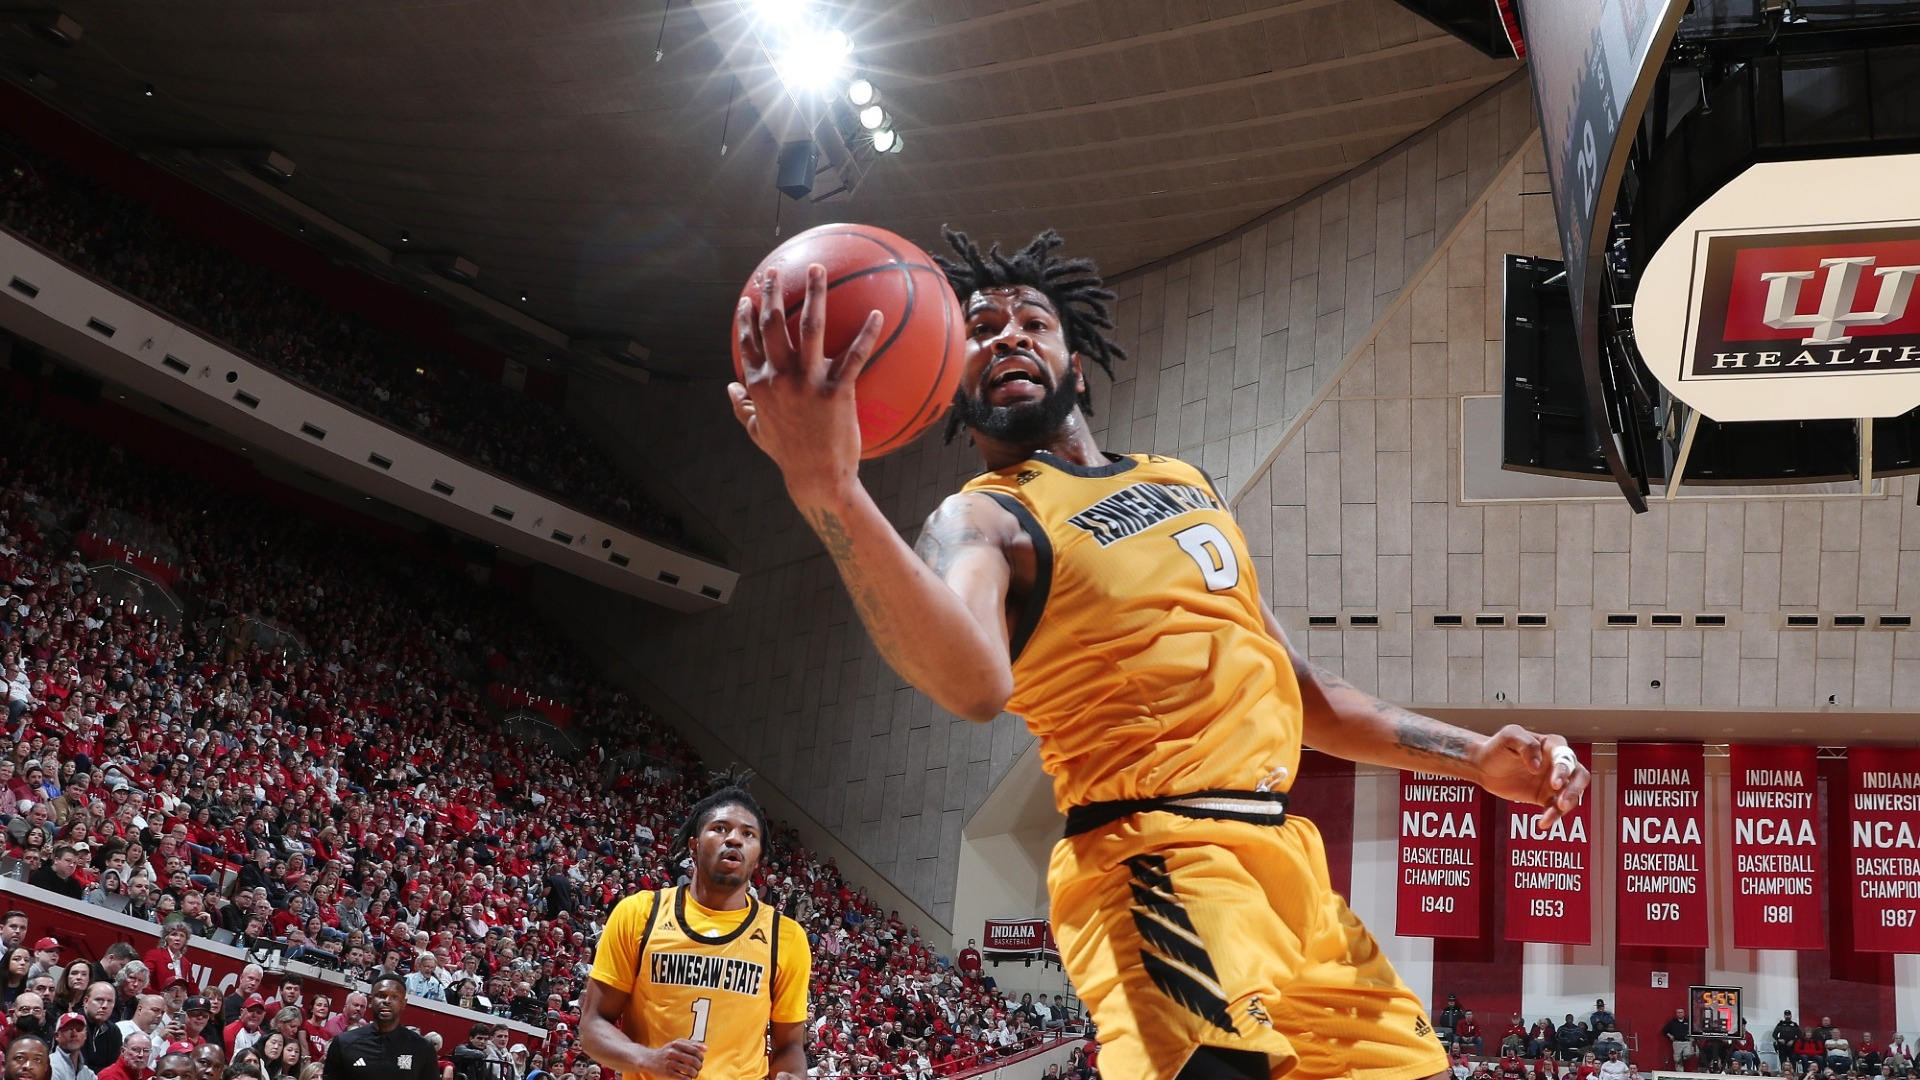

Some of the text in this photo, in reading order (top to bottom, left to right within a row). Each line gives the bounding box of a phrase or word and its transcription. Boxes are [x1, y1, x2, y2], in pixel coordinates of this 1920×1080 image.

[1578, 119, 1597, 219] 29
[1711, 345, 1920, 369] HEALTH
[1066, 482, 1190, 547] KENNESAW
[125, 551, 134, 564] E
[528, 696, 535, 706] F
[1634, 769, 1690, 785] INDIANA
[1746, 769, 1804, 786] INDIANA
[1863, 772, 1920, 789] INDIANA
[1405, 785, 1475, 802] UNIVERSITY
[1624, 790, 1699, 807] UNIVERSITY
[1737, 791, 1813, 809] UNIVERSITY
[1402, 811, 1477, 838] NCAA
[1510, 813, 1587, 843] NCAA
[1622, 817, 1702, 844] NCAA
[1735, 818, 1816, 846] NCAA
[1853, 821, 1920, 848] NCA
[1403, 847, 1474, 866] BASKETBALL
[1511, 850, 1584, 870] BASKETBALL
[1624, 853, 1699, 872] BASKETBALL
[1738, 855, 1815, 873] BASKETBALL
[1404, 869, 1470, 886] CHAMPIONS
[1514, 872, 1581, 892] CHAMPIONS
[1627, 875, 1696, 894] CHAMPIONS
[1741, 877, 1813, 895] CHAMPIONS
[1861, 881, 1920, 898] CHAMPIO
[1421, 896, 1454, 913] 1940
[1530, 899, 1564, 917] 1953
[1646, 903, 1680, 921] 1976
[1763, 905, 1793, 923] 1981
[1881, 909, 1916, 927] 1987
[991, 926, 1035, 938] INDIANA
[651, 953, 763, 995] KENNESAW STATE
[1657, 977, 1662, 986] 6
[688, 997, 711, 1042] 1
